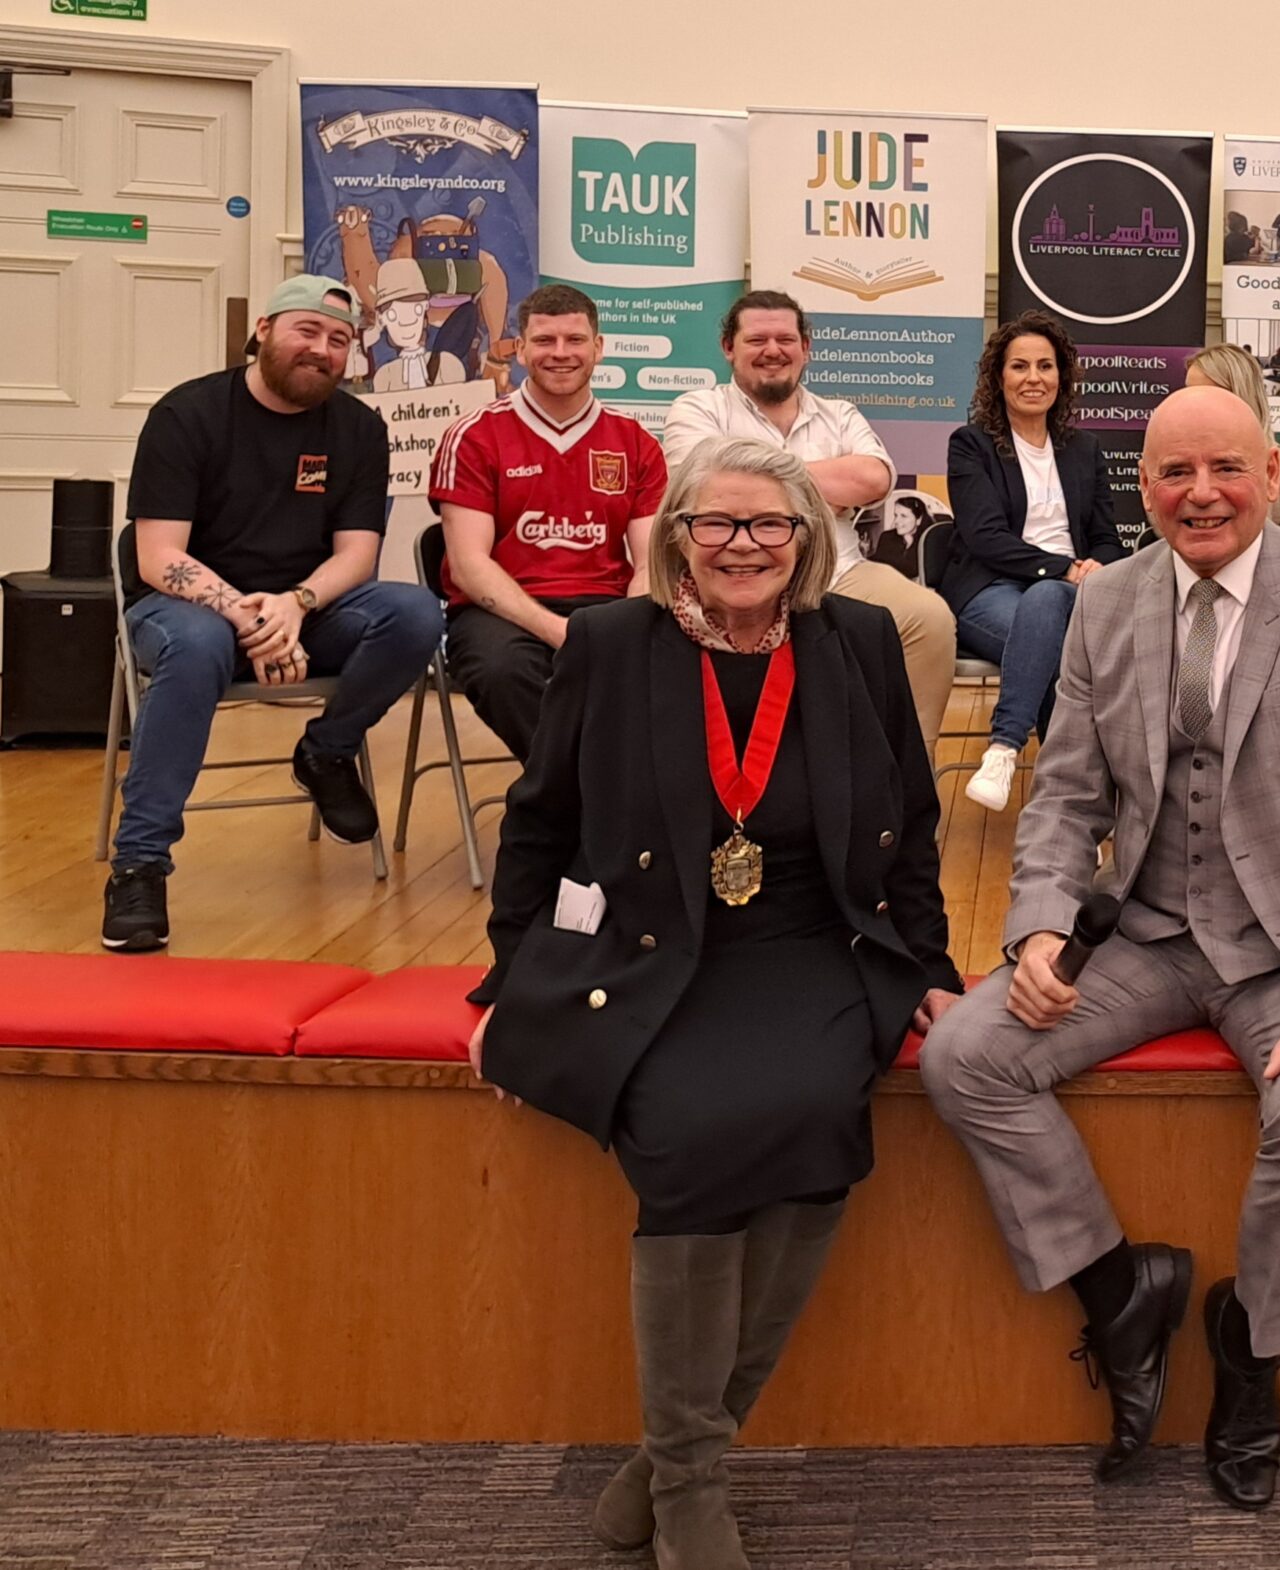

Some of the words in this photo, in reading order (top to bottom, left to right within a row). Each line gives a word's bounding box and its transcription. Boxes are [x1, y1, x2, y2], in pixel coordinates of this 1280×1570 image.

[367, 114, 436, 138] Kingsley
[453, 119, 476, 138] Co
[807, 129, 929, 192] JUDE
[333, 173, 506, 192] www.kingsleyandco.org
[577, 170, 690, 217] TAUK
[805, 199, 929, 240] LENNON
[580, 223, 688, 254] Publishing
[593, 299, 612, 309] me
[615, 298, 630, 309] for
[632, 298, 703, 312] self-published
[630, 312, 639, 323] in
[642, 312, 659, 323] the
[661, 314, 676, 325] UK
[812, 327, 955, 344] udeLennonAuthor
[614, 341, 650, 352] Fiction
[809, 349, 934, 365] udelennonbooks
[1077, 355, 1167, 370] rpoolReads
[648, 374, 706, 386] Non-fiction
[1074, 381, 1170, 396] rpoolWrites
[391, 399, 460, 422] children's
[1078, 406, 1154, 422] poolSpea
[388, 433, 436, 456] okshop
[388, 469, 422, 489] racy
[1116, 466, 1140, 476] LITE
[515, 510, 607, 550] Carlsberg
